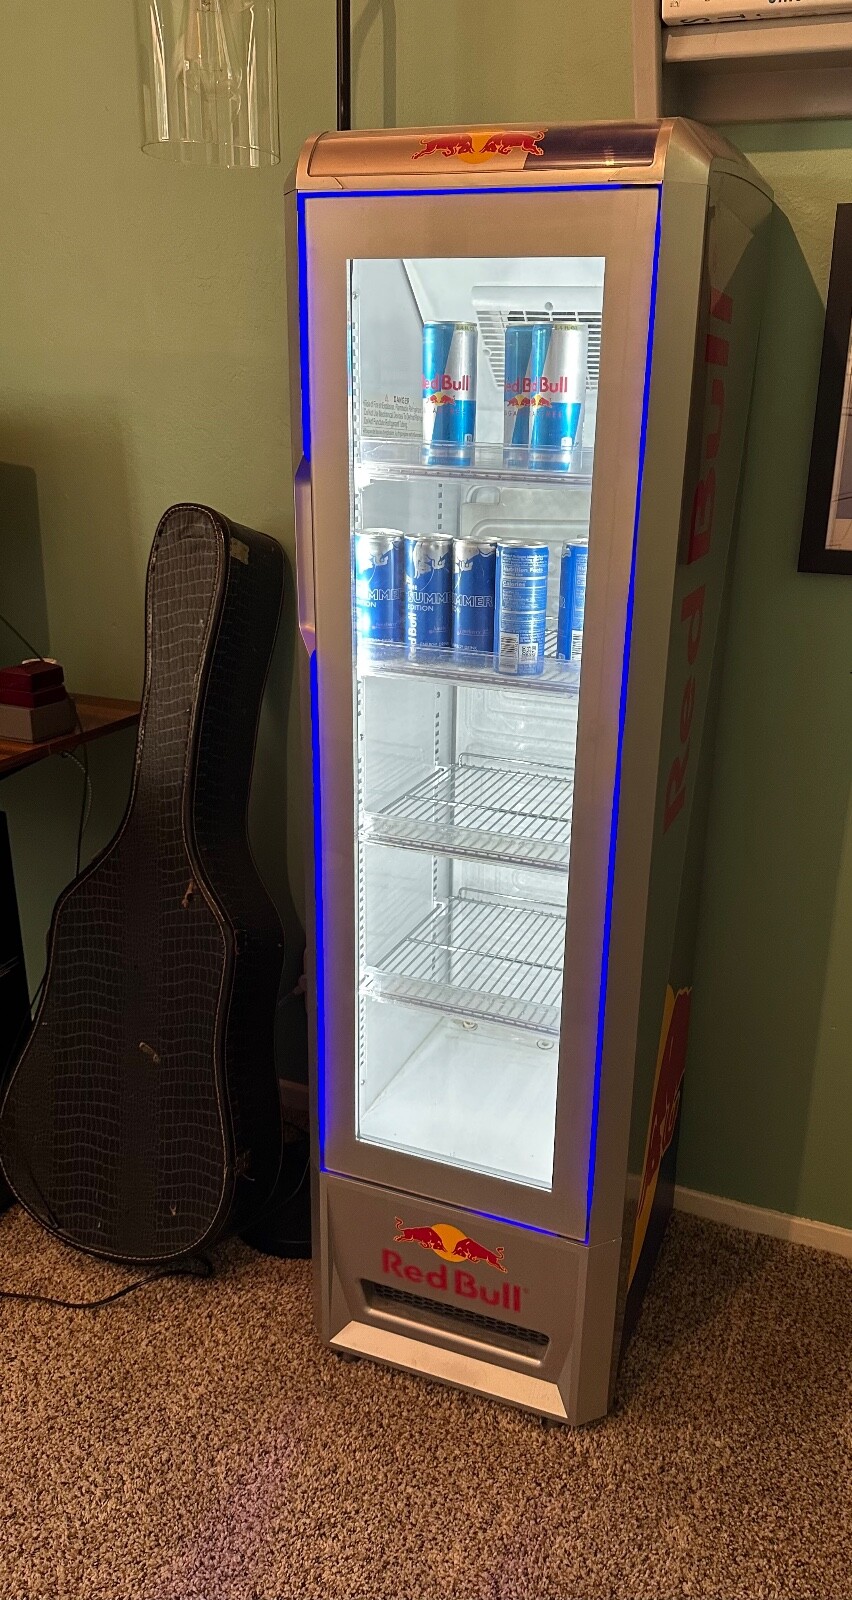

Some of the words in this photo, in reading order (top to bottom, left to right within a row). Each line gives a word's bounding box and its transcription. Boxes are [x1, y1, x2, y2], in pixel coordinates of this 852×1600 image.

[441, 374, 469, 391] Bull
[504, 376, 520, 392] ed
[540, 376, 568, 393] Bull
[663, 585, 705, 834] Red
[687, 287, 733, 565] Bull
[408, 591, 450, 604] SUMM
[453, 593, 494, 608] MMER
[381, 1248, 448, 1290] Red
[454, 1269, 522, 1313] Bull
